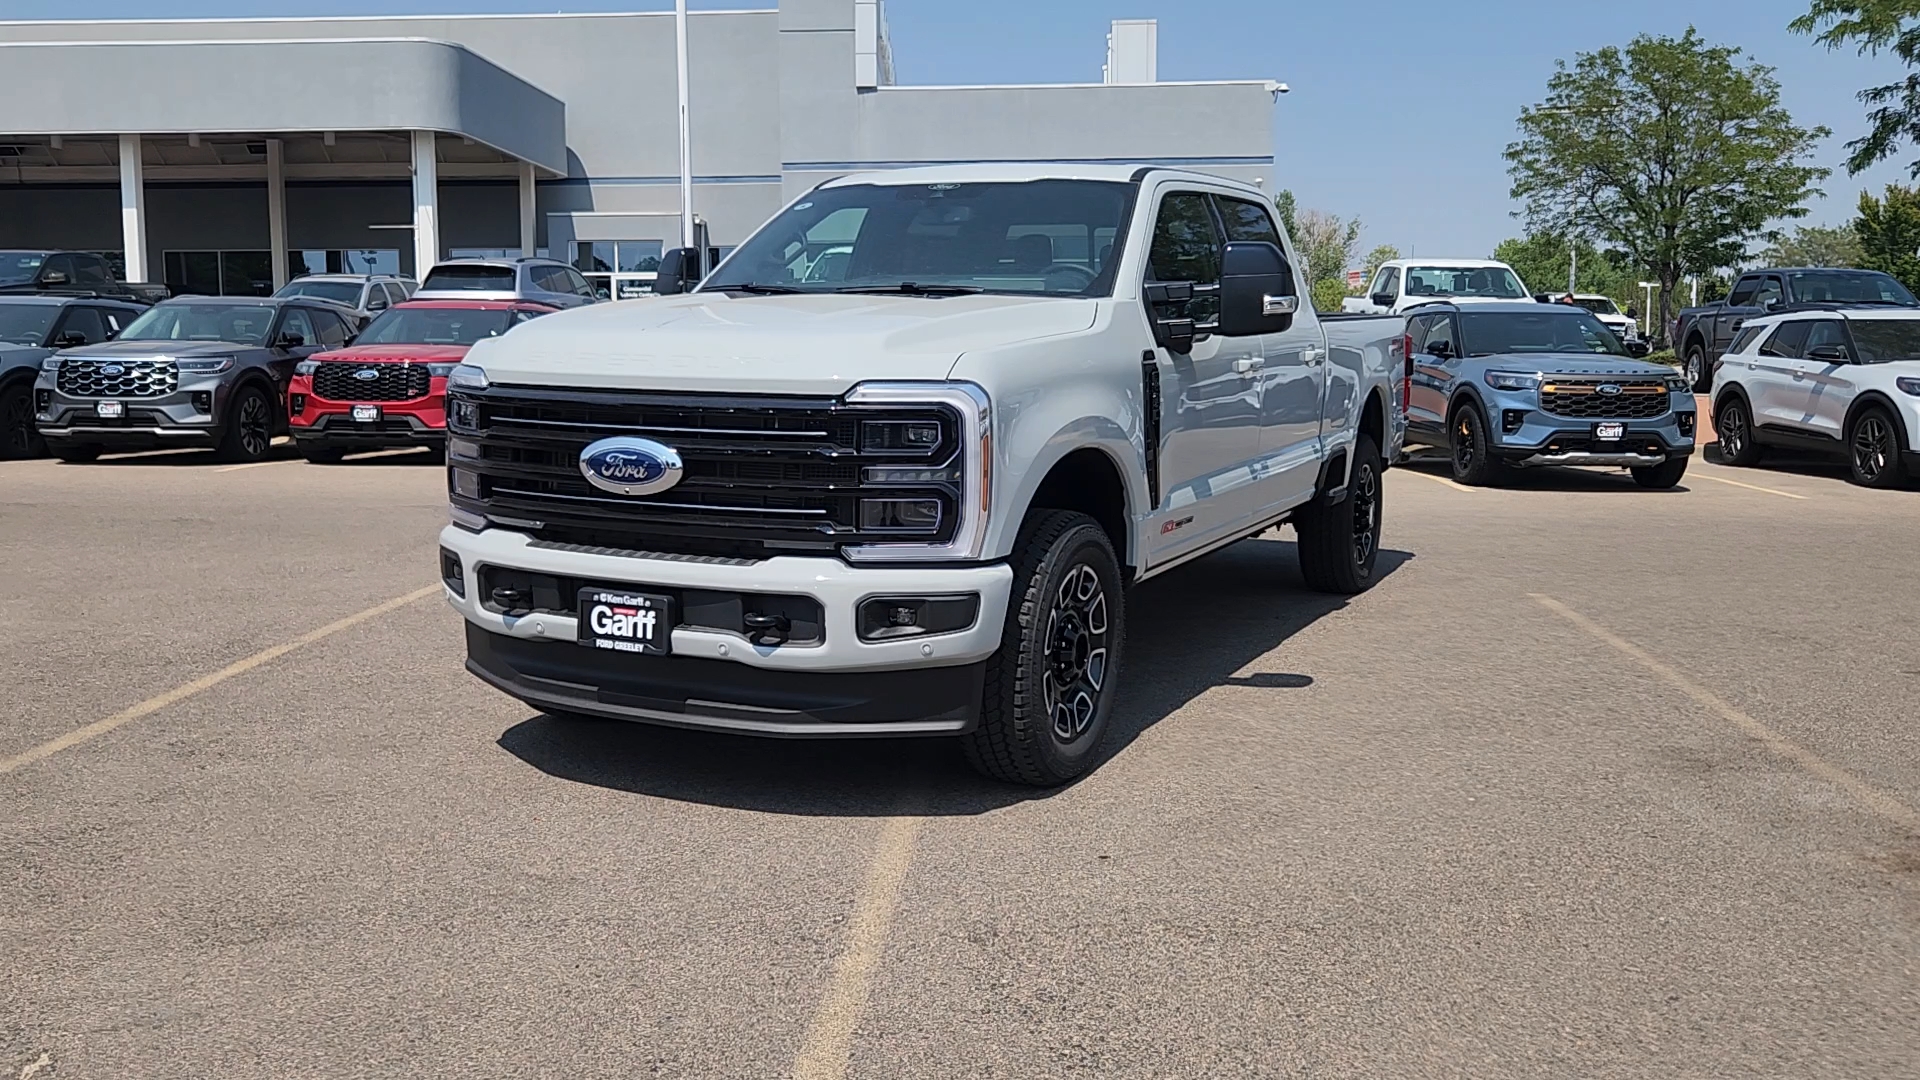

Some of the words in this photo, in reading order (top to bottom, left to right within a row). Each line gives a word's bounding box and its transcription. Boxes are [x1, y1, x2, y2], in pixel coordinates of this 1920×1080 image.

[97, 403, 122, 414] Garff
[353, 408, 378, 419] Garff
[1596, 426, 1624, 437] Garff
[601, 452, 649, 479] Ford
[607, 593, 624, 605] Ken
[623, 595, 645, 607] Garff
[590, 604, 656, 640] Garff
[595, 638, 614, 650] FORD
[613, 640, 645, 653] GREELEY
